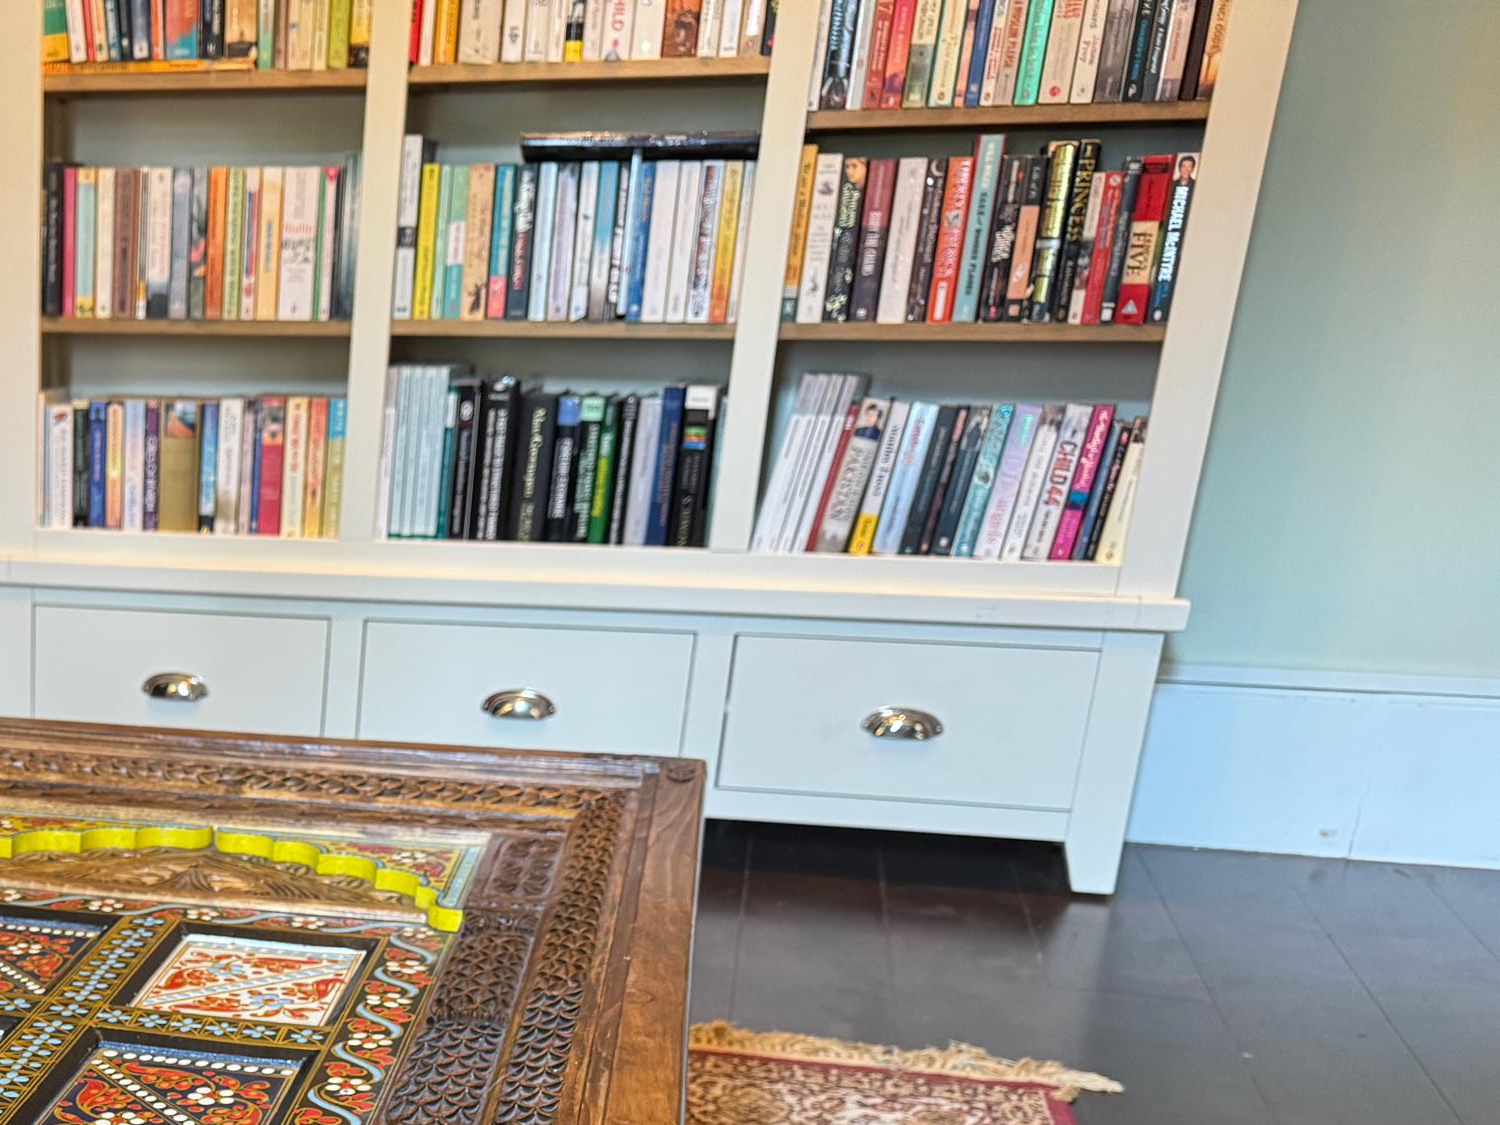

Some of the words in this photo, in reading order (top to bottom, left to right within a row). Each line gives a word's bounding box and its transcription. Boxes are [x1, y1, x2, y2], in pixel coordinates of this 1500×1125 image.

[1066, 157, 1095, 242] PRINCESS
[1168, 184, 1188, 232] MICHAEL
[1157, 230, 1180, 283] McINTYRE
[1048, 438, 1078, 486] CHILD
